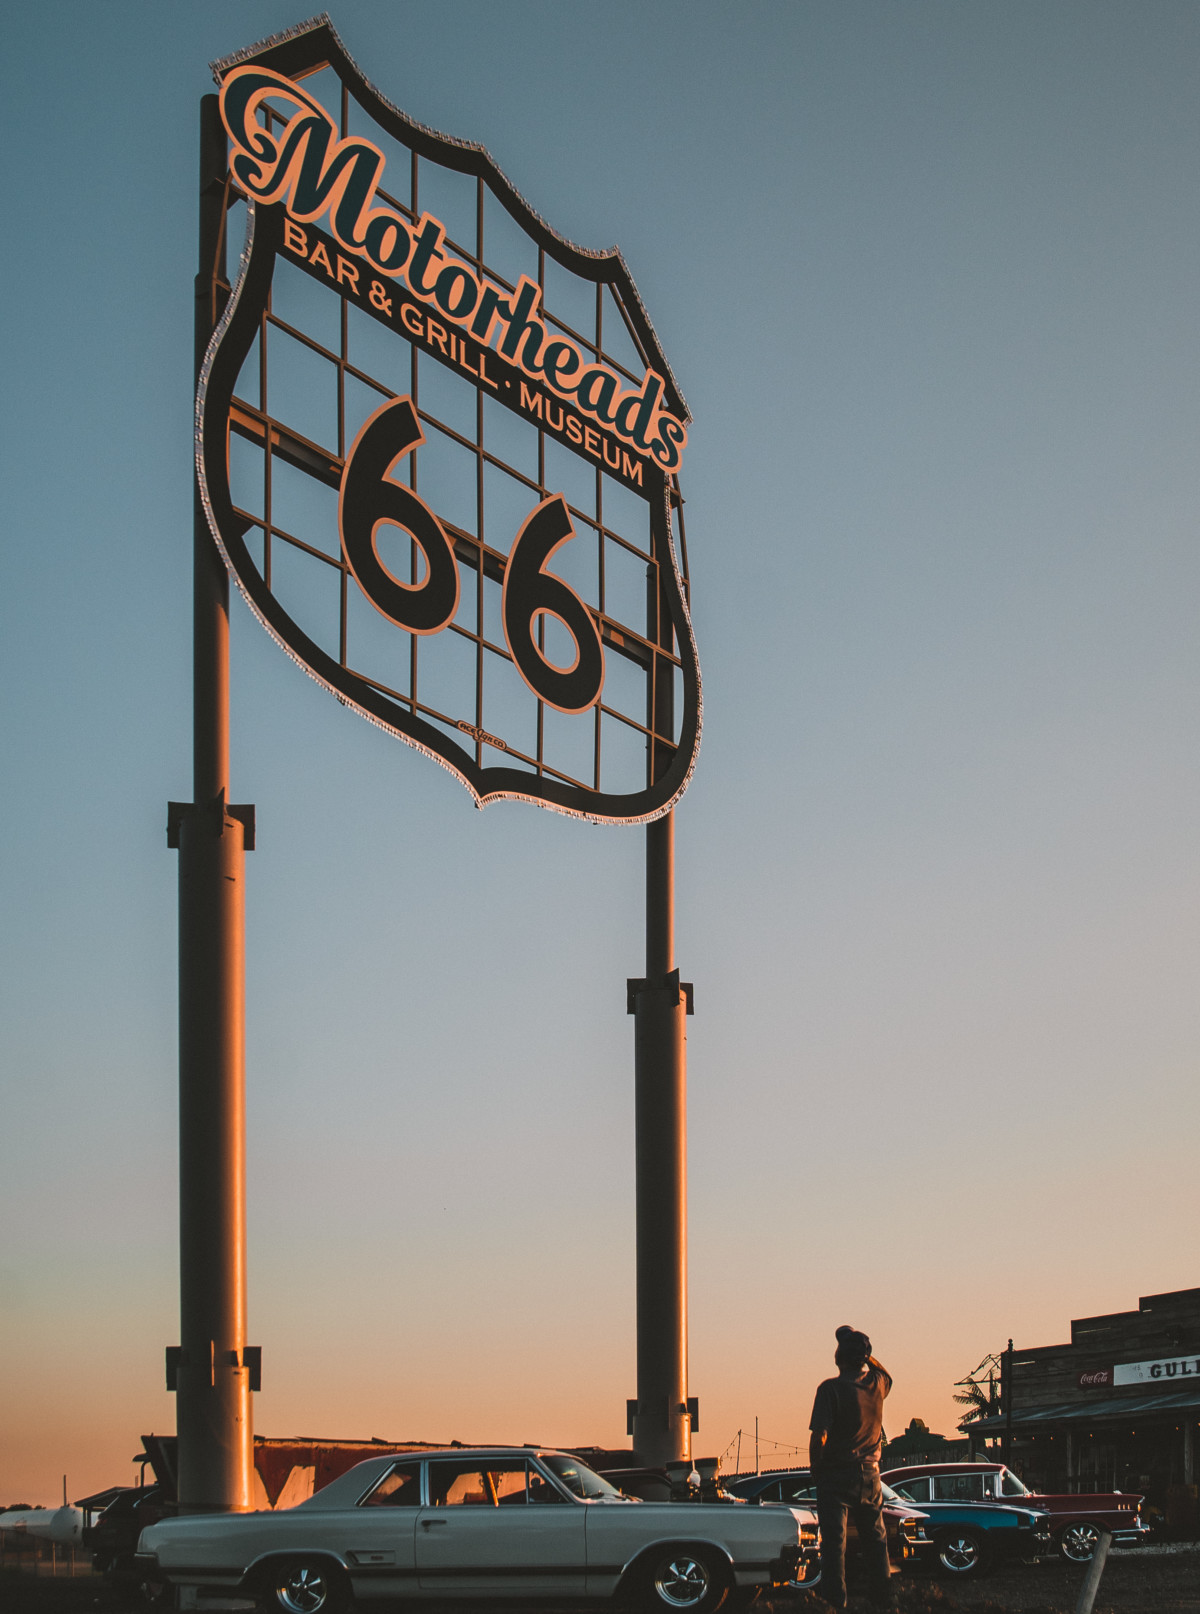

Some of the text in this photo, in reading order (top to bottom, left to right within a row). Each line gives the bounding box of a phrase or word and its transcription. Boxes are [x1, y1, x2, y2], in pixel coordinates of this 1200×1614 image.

[220, 66, 688, 473] Motorheads
[283, 217, 643, 488] BAR & GRILL MUSEUM
[338, 393, 605, 715] 66
